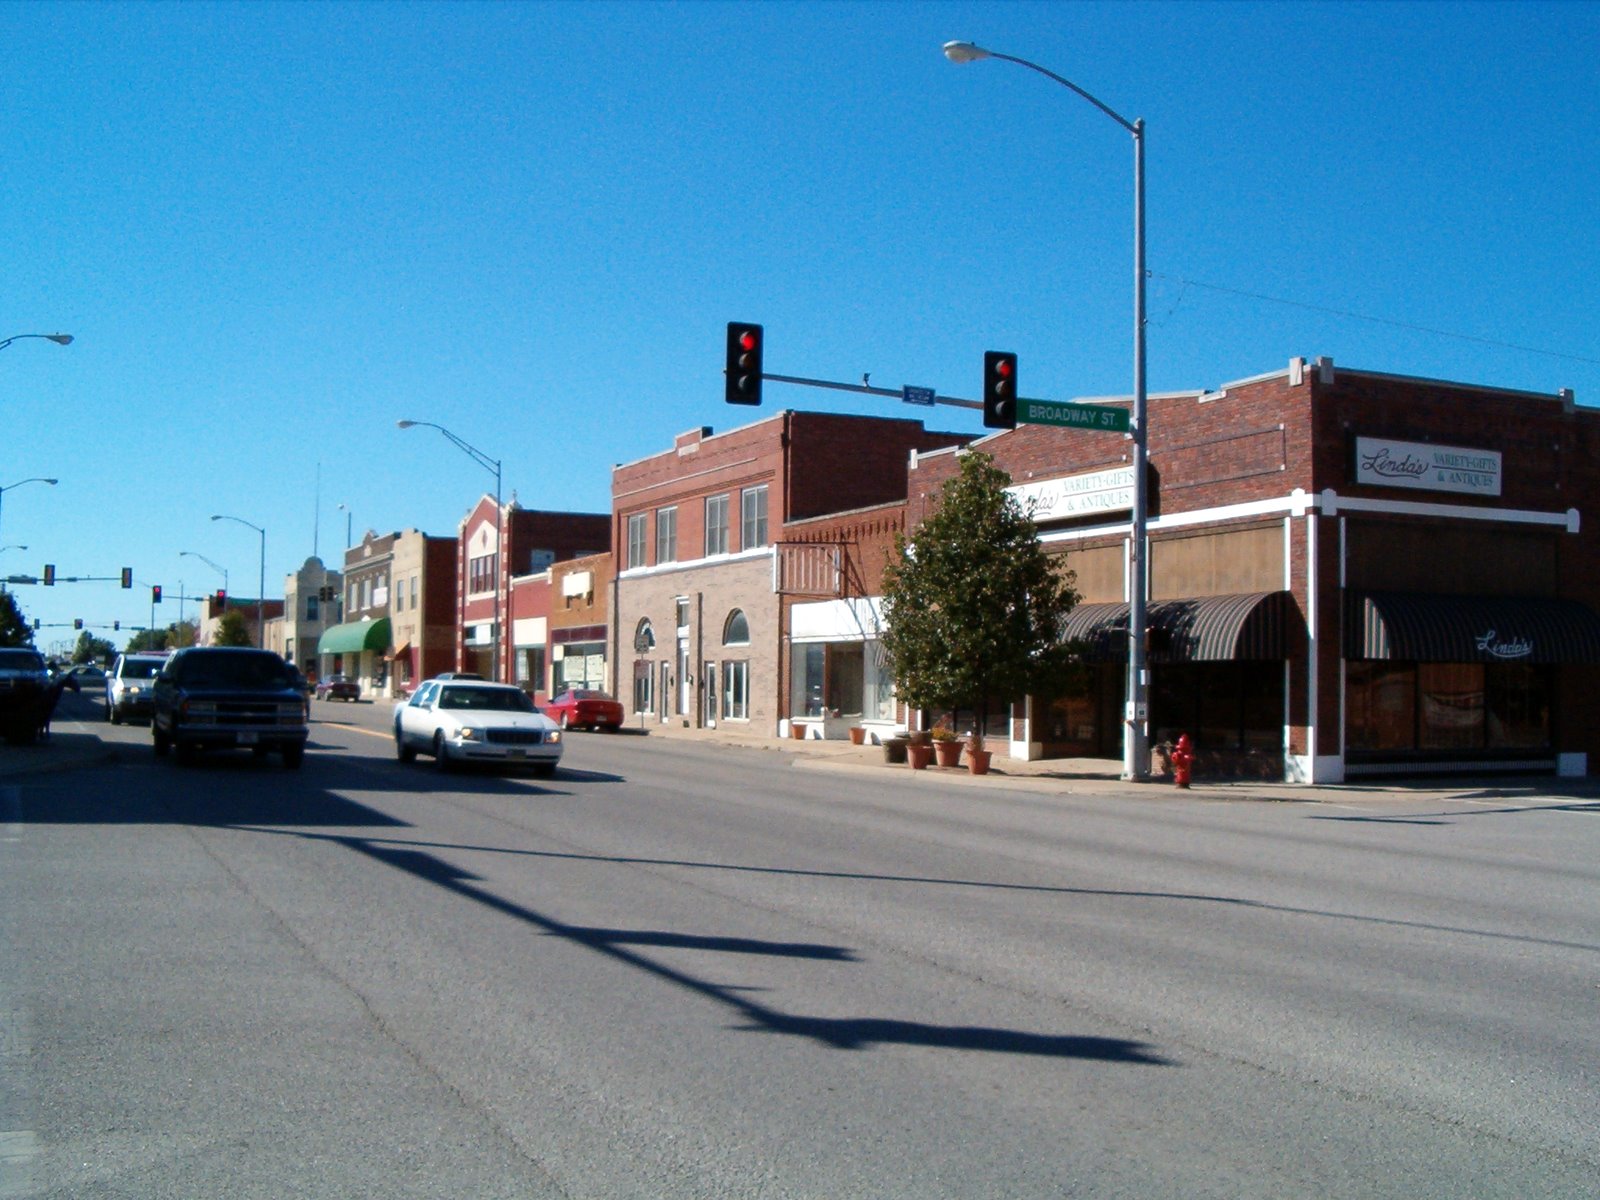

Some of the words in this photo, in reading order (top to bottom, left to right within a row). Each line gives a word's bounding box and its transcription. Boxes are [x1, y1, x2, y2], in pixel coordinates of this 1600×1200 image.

[1029, 404, 1097, 423] BROADWAY
[1362, 447, 1429, 479] Linda's
[1437, 470, 1444, 482] &
[1449, 471, 1493, 487] ANTIQUES
[1016, 486, 1059, 516] da's
[1067, 501, 1075, 511] &
[1080, 490, 1129, 507] ANTIQUES
[1475, 630, 1533, 658] Linda's
